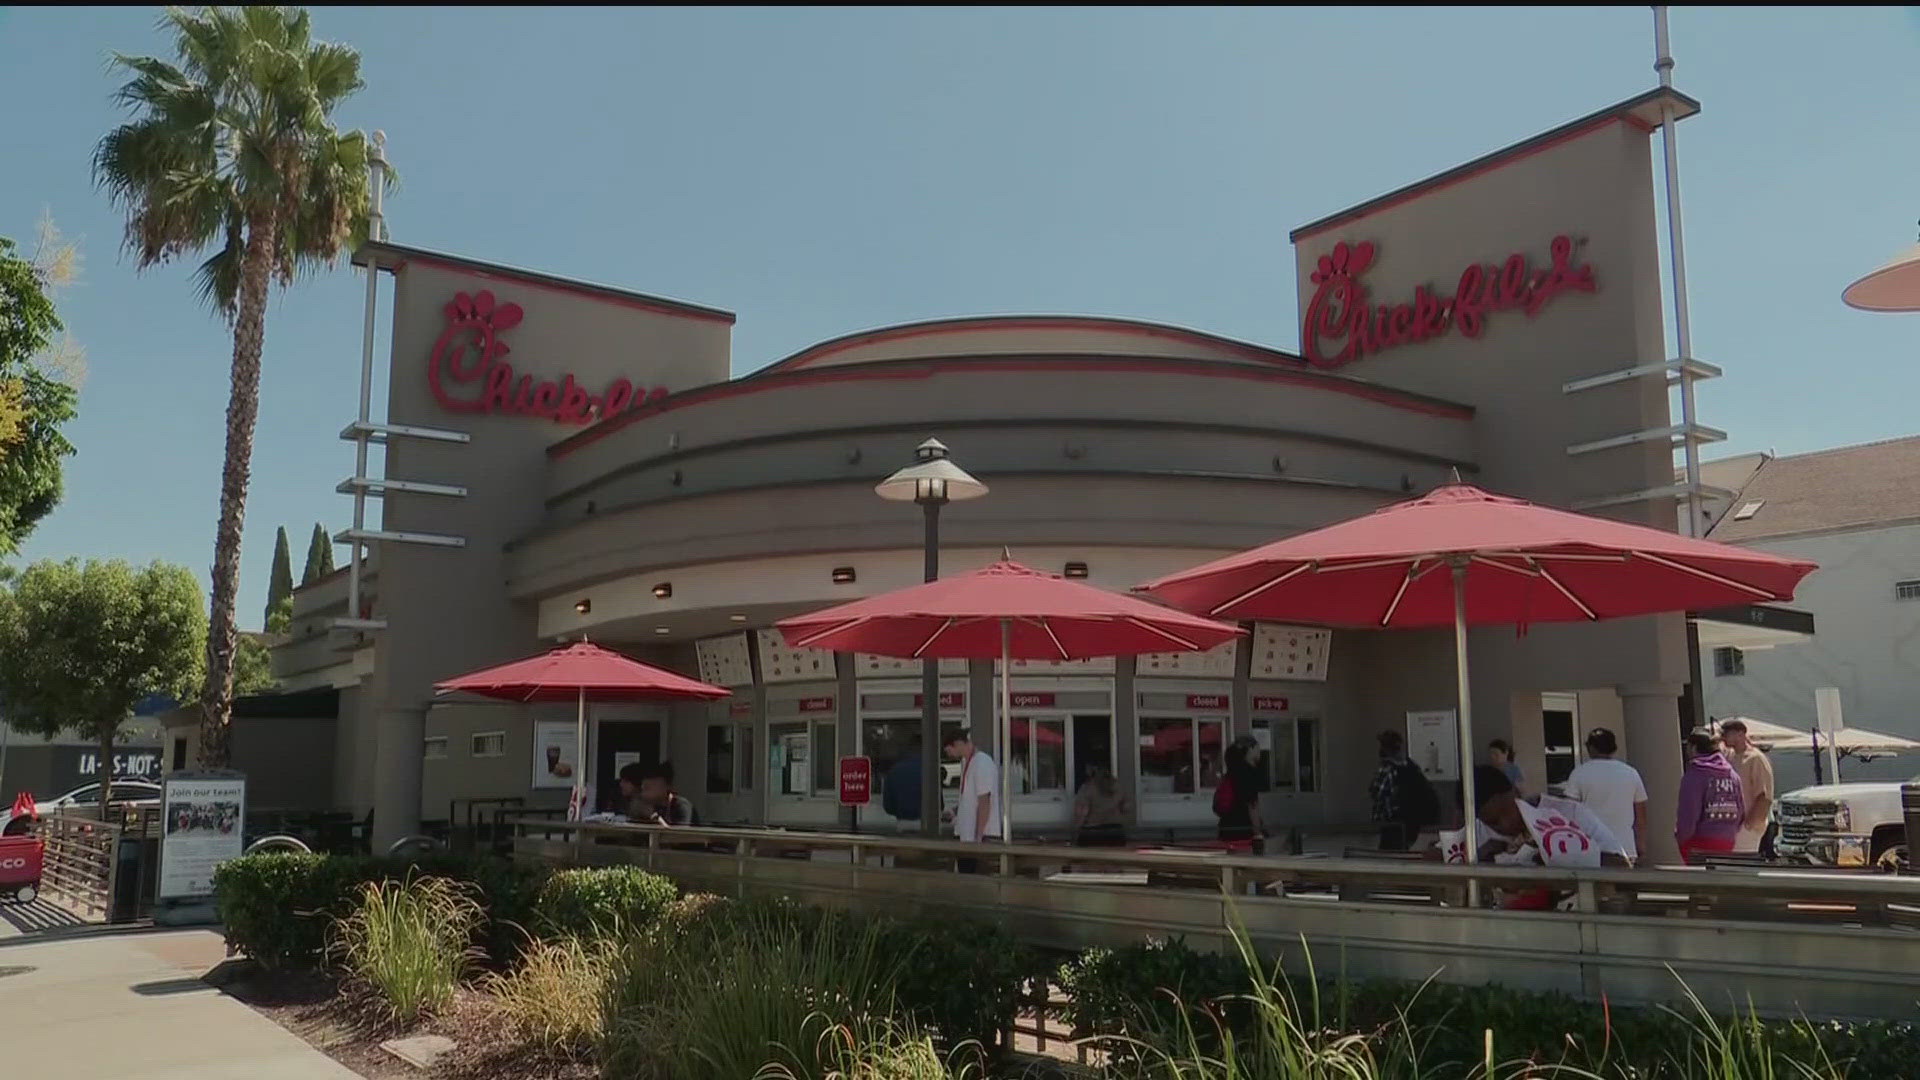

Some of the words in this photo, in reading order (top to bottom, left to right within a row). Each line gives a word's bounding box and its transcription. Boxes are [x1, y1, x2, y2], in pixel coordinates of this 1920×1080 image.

[1303, 236, 1597, 368] Chick-fil-A
[1015, 695, 1040, 706] open
[842, 770, 867, 780] order
[844, 781, 865, 791] here
[170, 788, 192, 798] Join
[193, 789, 210, 798] our
